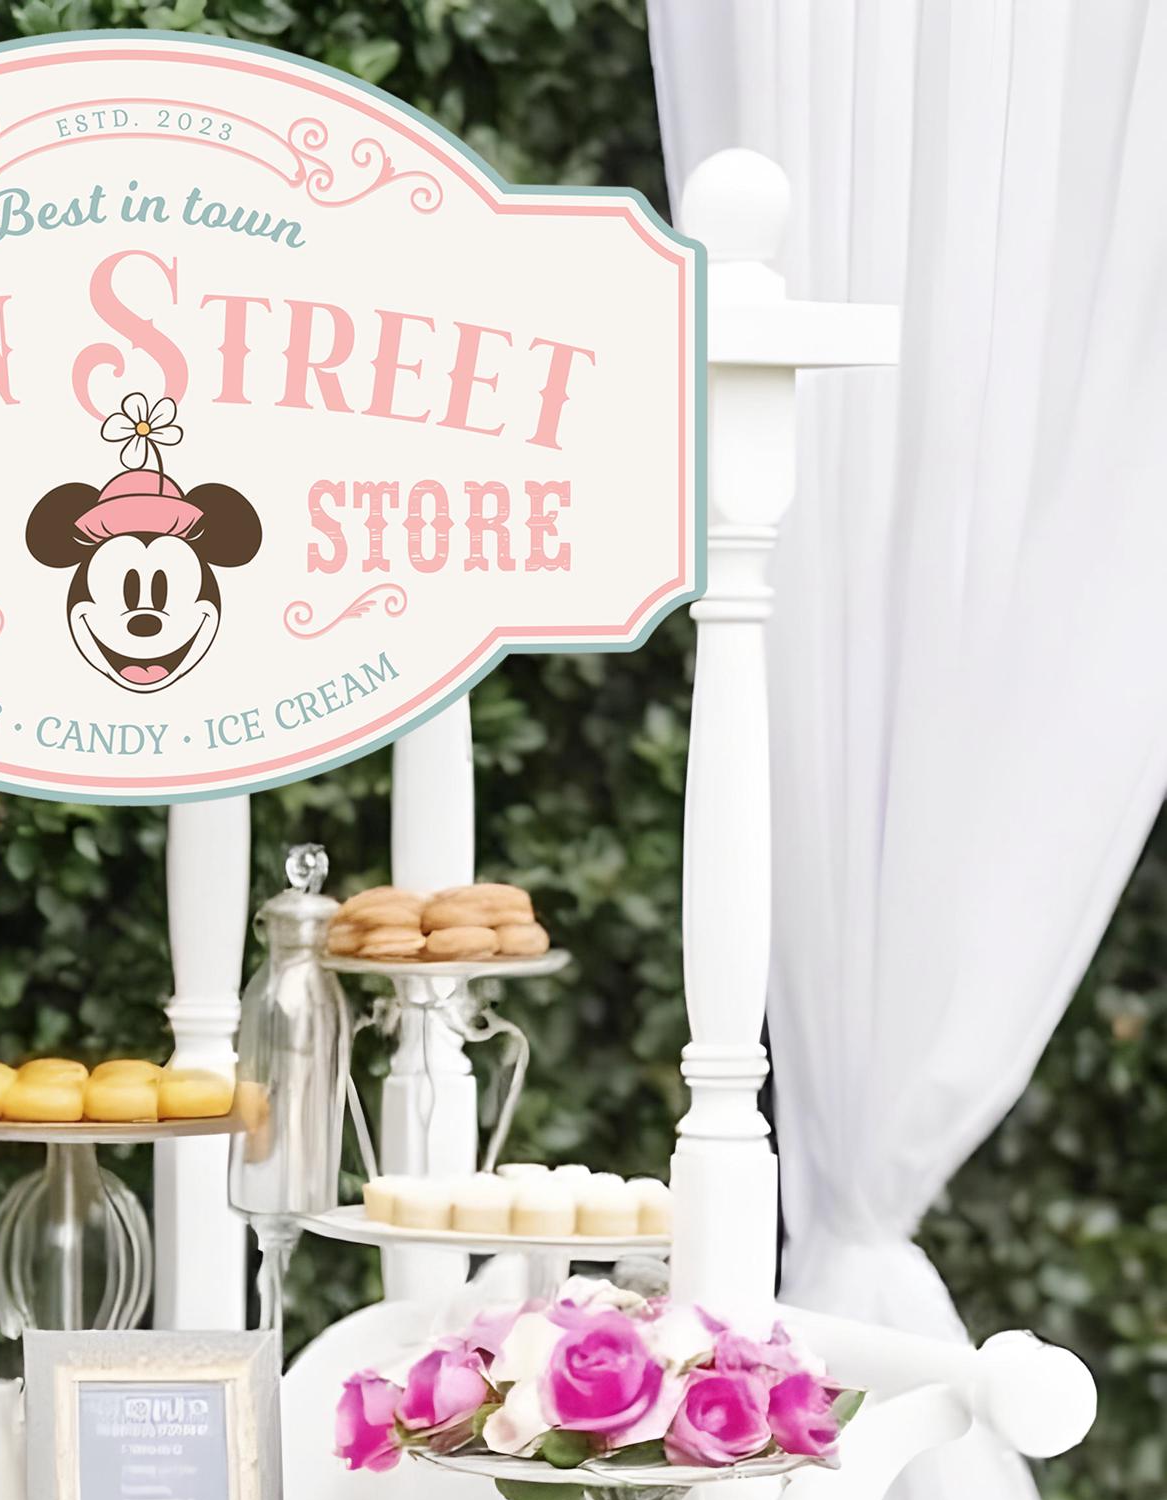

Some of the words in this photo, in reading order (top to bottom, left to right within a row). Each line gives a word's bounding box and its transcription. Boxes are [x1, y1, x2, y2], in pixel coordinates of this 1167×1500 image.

[57, 109, 140, 138] ESTD.
[157, 109, 234, 141] 2023
[120, 180, 170, 224] in
[183, 185, 307, 249] town
[71, 249, 597, 450] STREET
[307, 479, 572, 574] STORE
[36, 716, 169, 756] CANDY
[203, 707, 266, 750] ICE
[274, 652, 400, 731] CREAM
